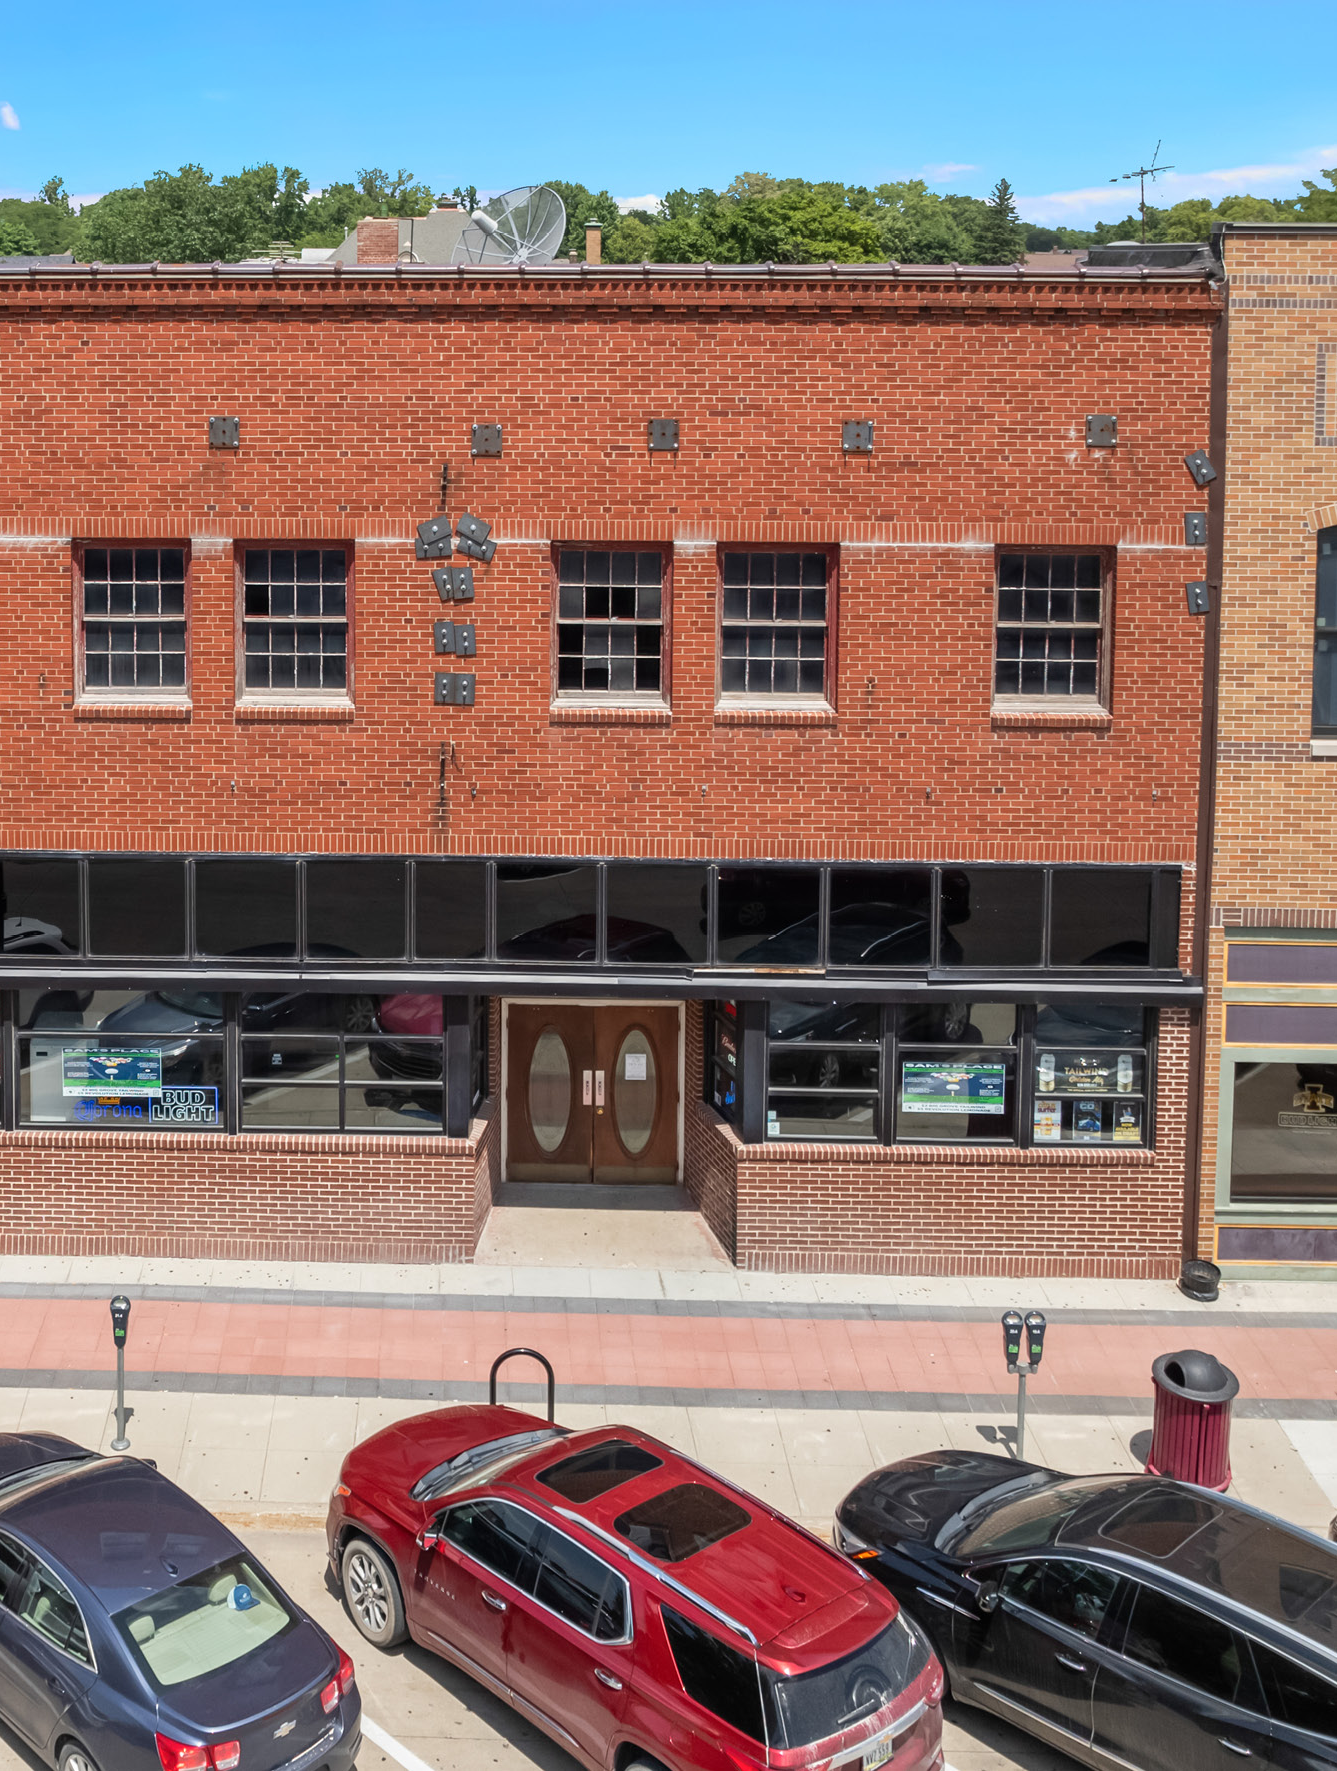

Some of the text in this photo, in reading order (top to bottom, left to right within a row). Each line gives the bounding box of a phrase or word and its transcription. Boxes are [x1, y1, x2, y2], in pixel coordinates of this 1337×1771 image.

[1064, 1067, 1109, 1076] TAILWIND
[161, 1089, 205, 1106] BUD
[74, 1100, 143, 1122] Corona
[152, 1105, 214, 1122] LIGHT
